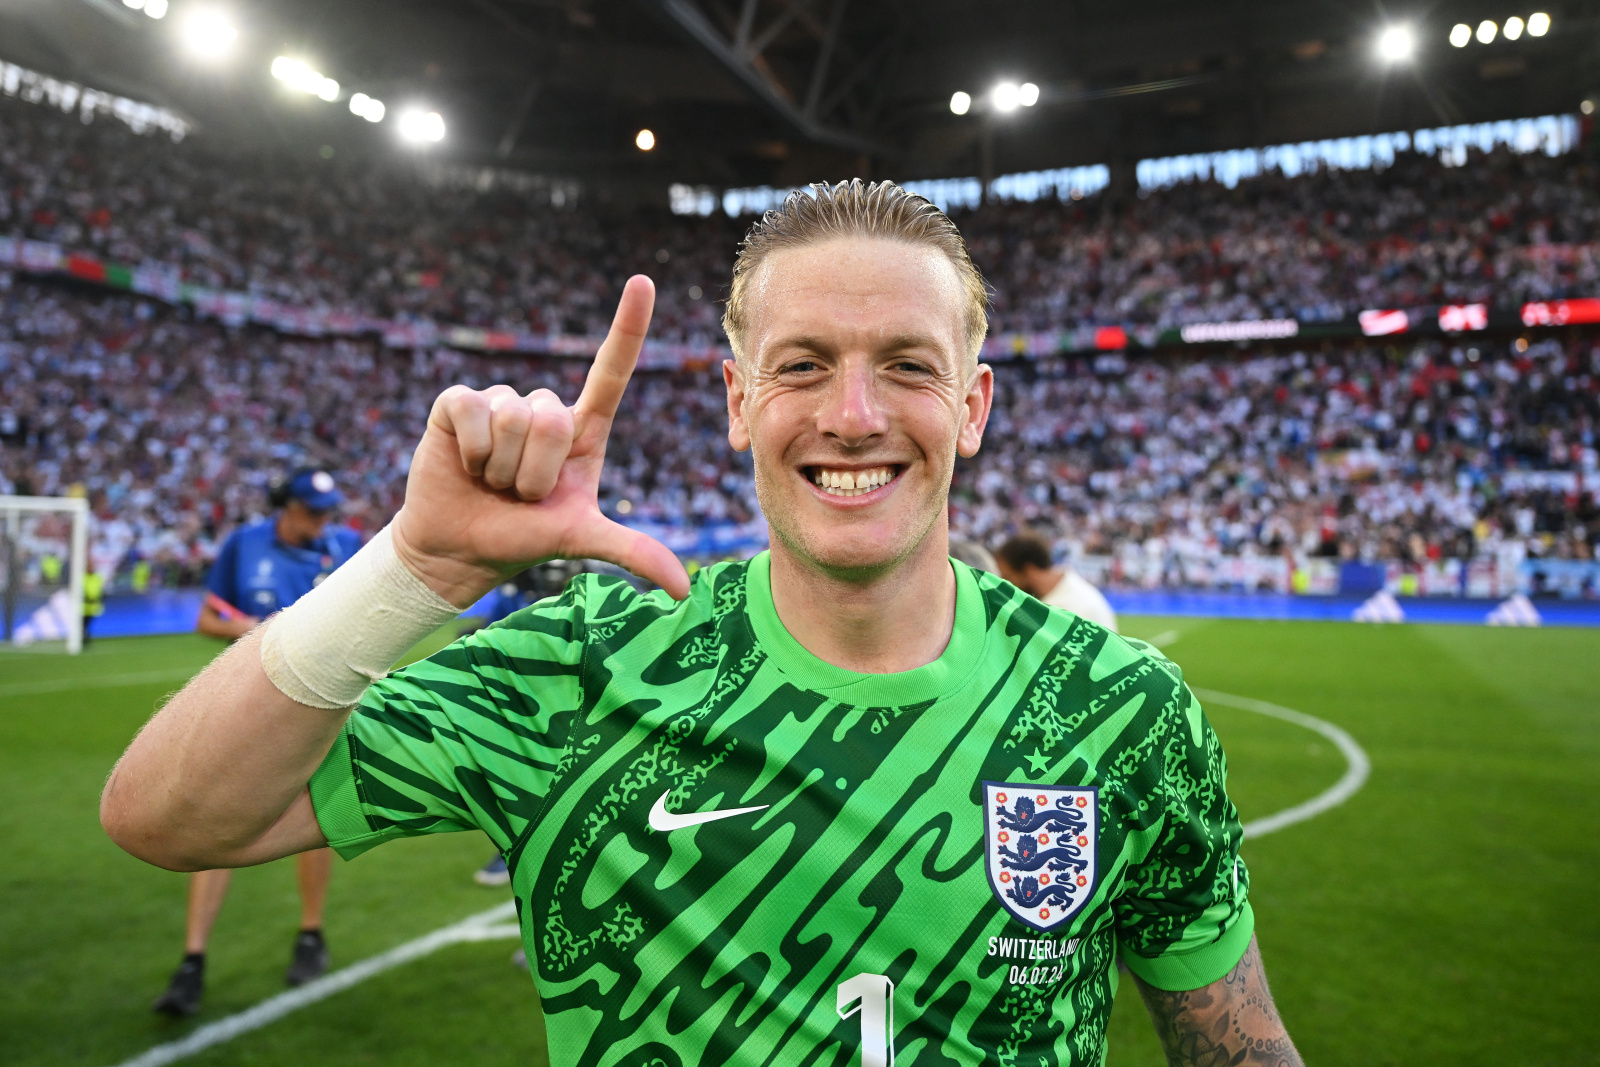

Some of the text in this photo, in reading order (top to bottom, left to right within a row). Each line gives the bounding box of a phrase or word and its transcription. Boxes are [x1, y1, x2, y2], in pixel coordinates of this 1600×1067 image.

[987, 936, 1080, 960] SWITZERLAND
[1009, 965, 1063, 985] 06.07.24
[836, 972, 894, 1067] 1
